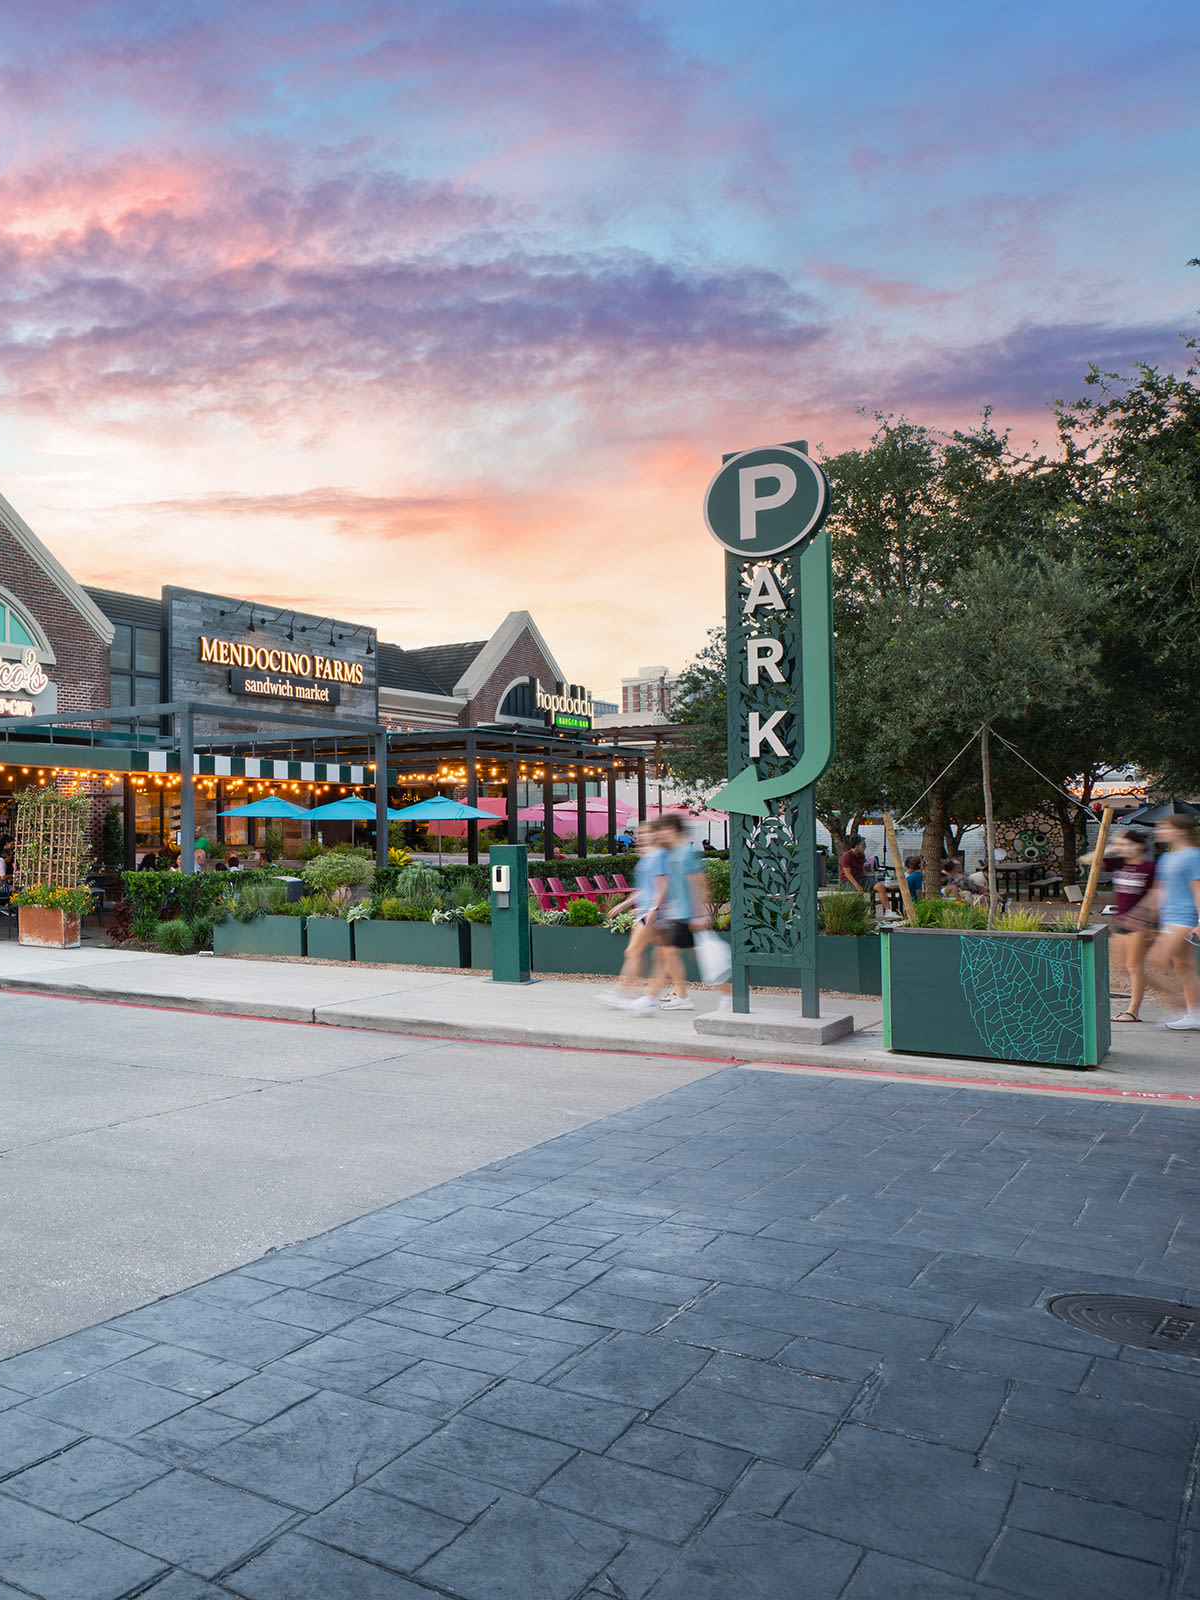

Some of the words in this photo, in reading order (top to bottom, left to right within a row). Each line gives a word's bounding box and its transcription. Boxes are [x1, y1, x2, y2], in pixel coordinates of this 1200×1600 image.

[200, 637, 311, 676] MENDOCINO
[314, 655, 363, 684] FARMS
[244, 677, 293, 697] sandwich
[295, 684, 329, 702] market
[536, 678, 594, 729] hopdoddy
[579, 719, 589, 729] BAR
